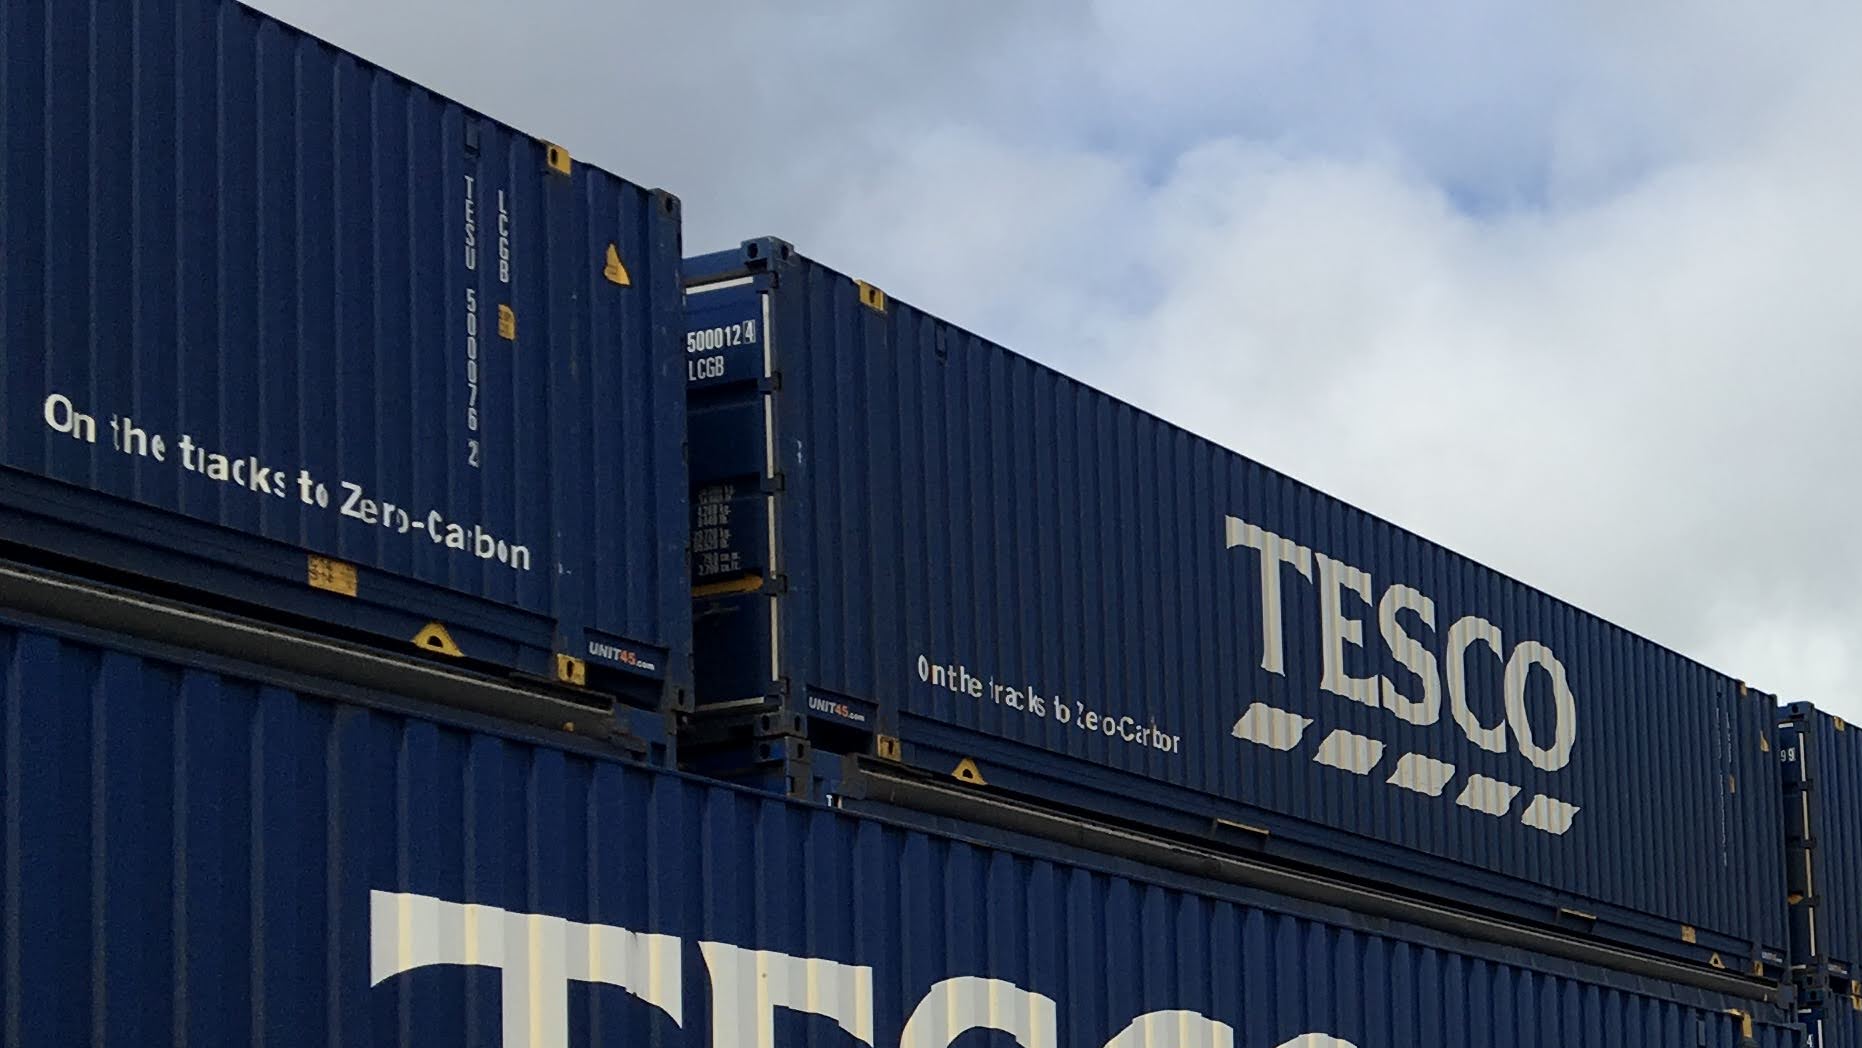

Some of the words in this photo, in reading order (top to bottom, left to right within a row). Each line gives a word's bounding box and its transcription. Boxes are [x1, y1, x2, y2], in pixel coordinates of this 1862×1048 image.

[688, 356, 725, 381] LCGB
[44, 393, 96, 443] On
[110, 413, 166, 462] the
[297, 470, 329, 508] to
[1226, 515, 1576, 772] TESCO
